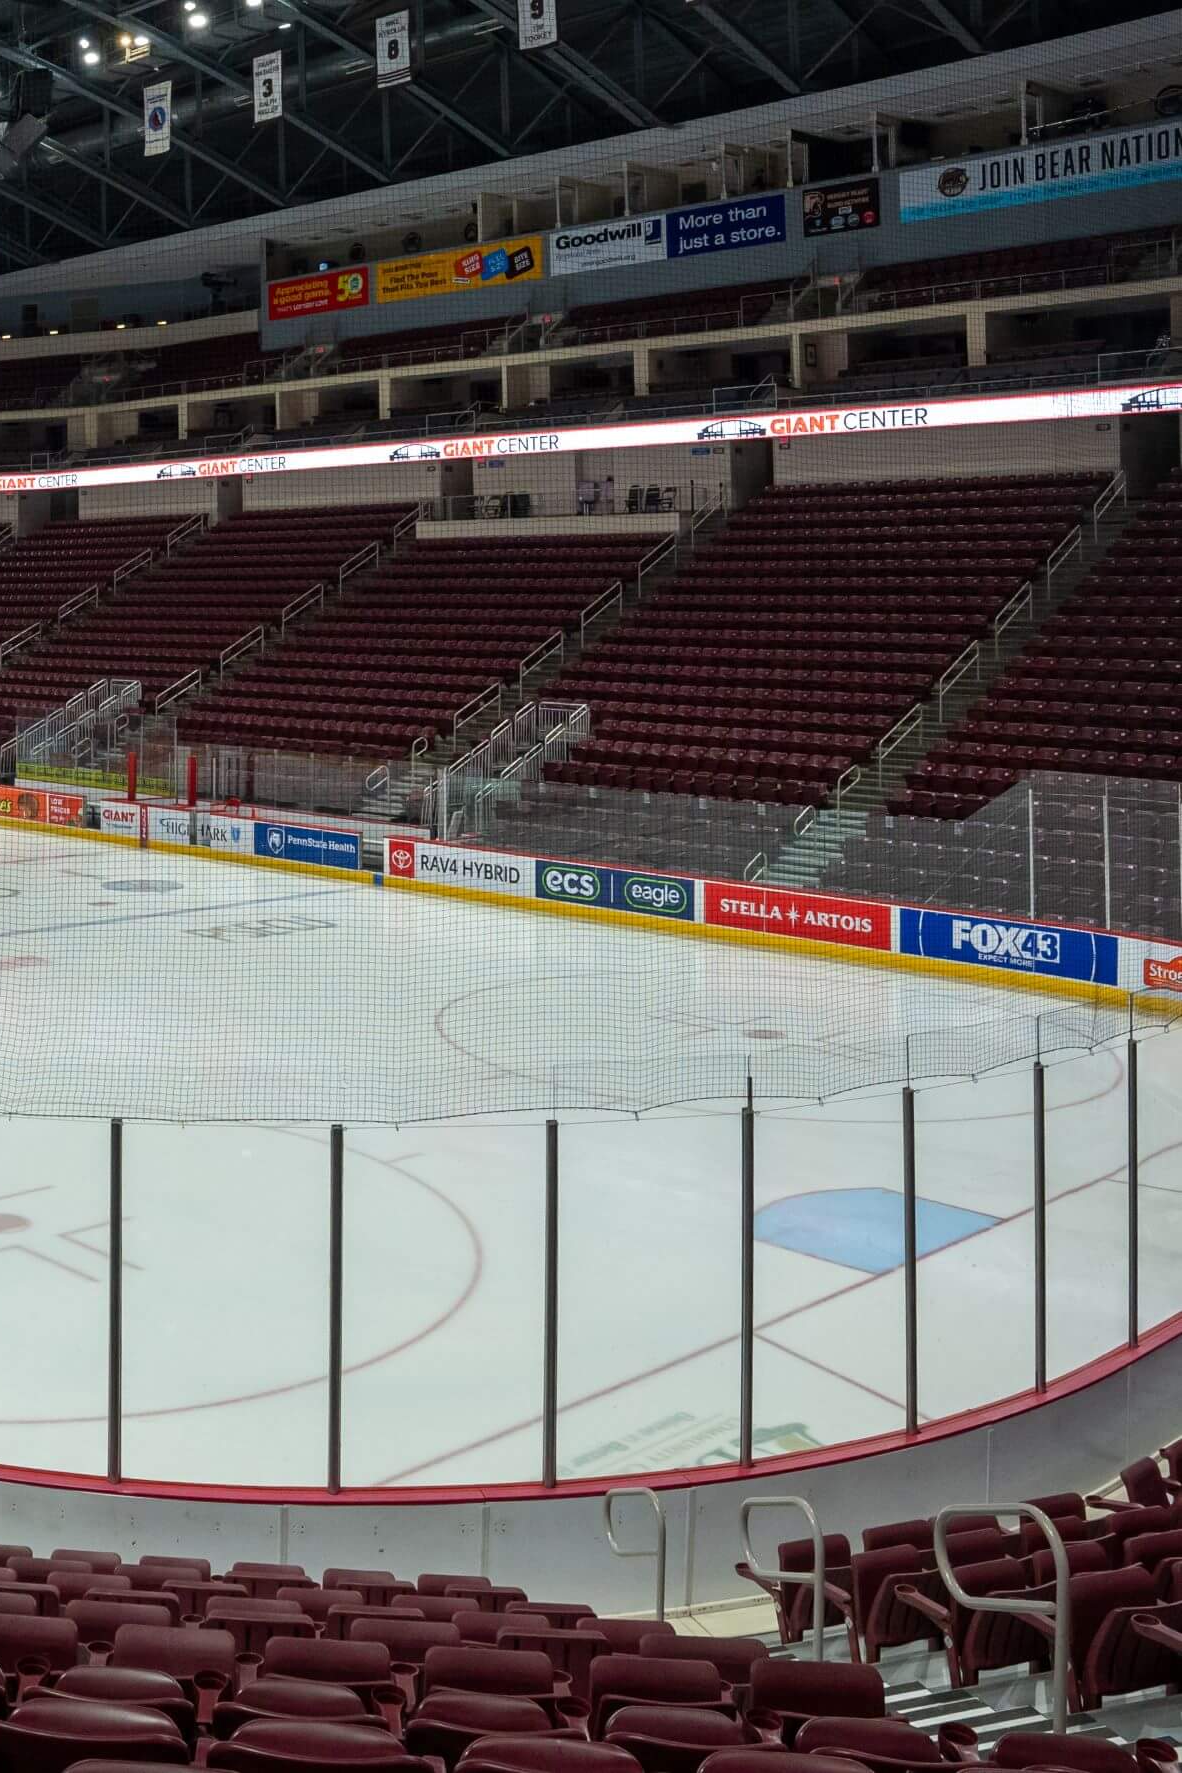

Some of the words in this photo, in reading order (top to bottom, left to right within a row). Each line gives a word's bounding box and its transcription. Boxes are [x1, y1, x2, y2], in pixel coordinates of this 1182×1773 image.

[388, 39, 399, 60] 8
[263, 79, 273, 97] 3
[979, 157, 1024, 190] JOIN
[1035, 146, 1091, 181] BEAR
[679, 214, 723, 231] More
[727, 205, 767, 222] than
[555, 222, 641, 250] Goodwill
[677, 236, 709, 254] just
[714, 233, 726, 245] a
[730, 224, 782, 243] store.
[770, 415, 840, 435] GIANT
[844, 407, 928, 430] CENTER
[443, 440, 494, 458] GIANT
[496, 434, 559, 454] CENTER
[198, 461, 237, 475] GIANT
[239, 457, 286, 472] CENTER
[38, 474, 78, 487] CENTER
[102, 809, 136, 823] GIANT
[328, 838, 356, 854] Health
[420, 854, 457, 876] RAV4
[463, 860, 520, 884] HYBRID
[545, 870, 595, 897] ecs
[631, 883, 680, 907] eagle
[720, 898, 783, 921] STELLA
[804, 910, 873, 933] ARTOIS
[978, 952, 1008, 965] EXPECT
[1009, 957, 1034, 968] MORE
